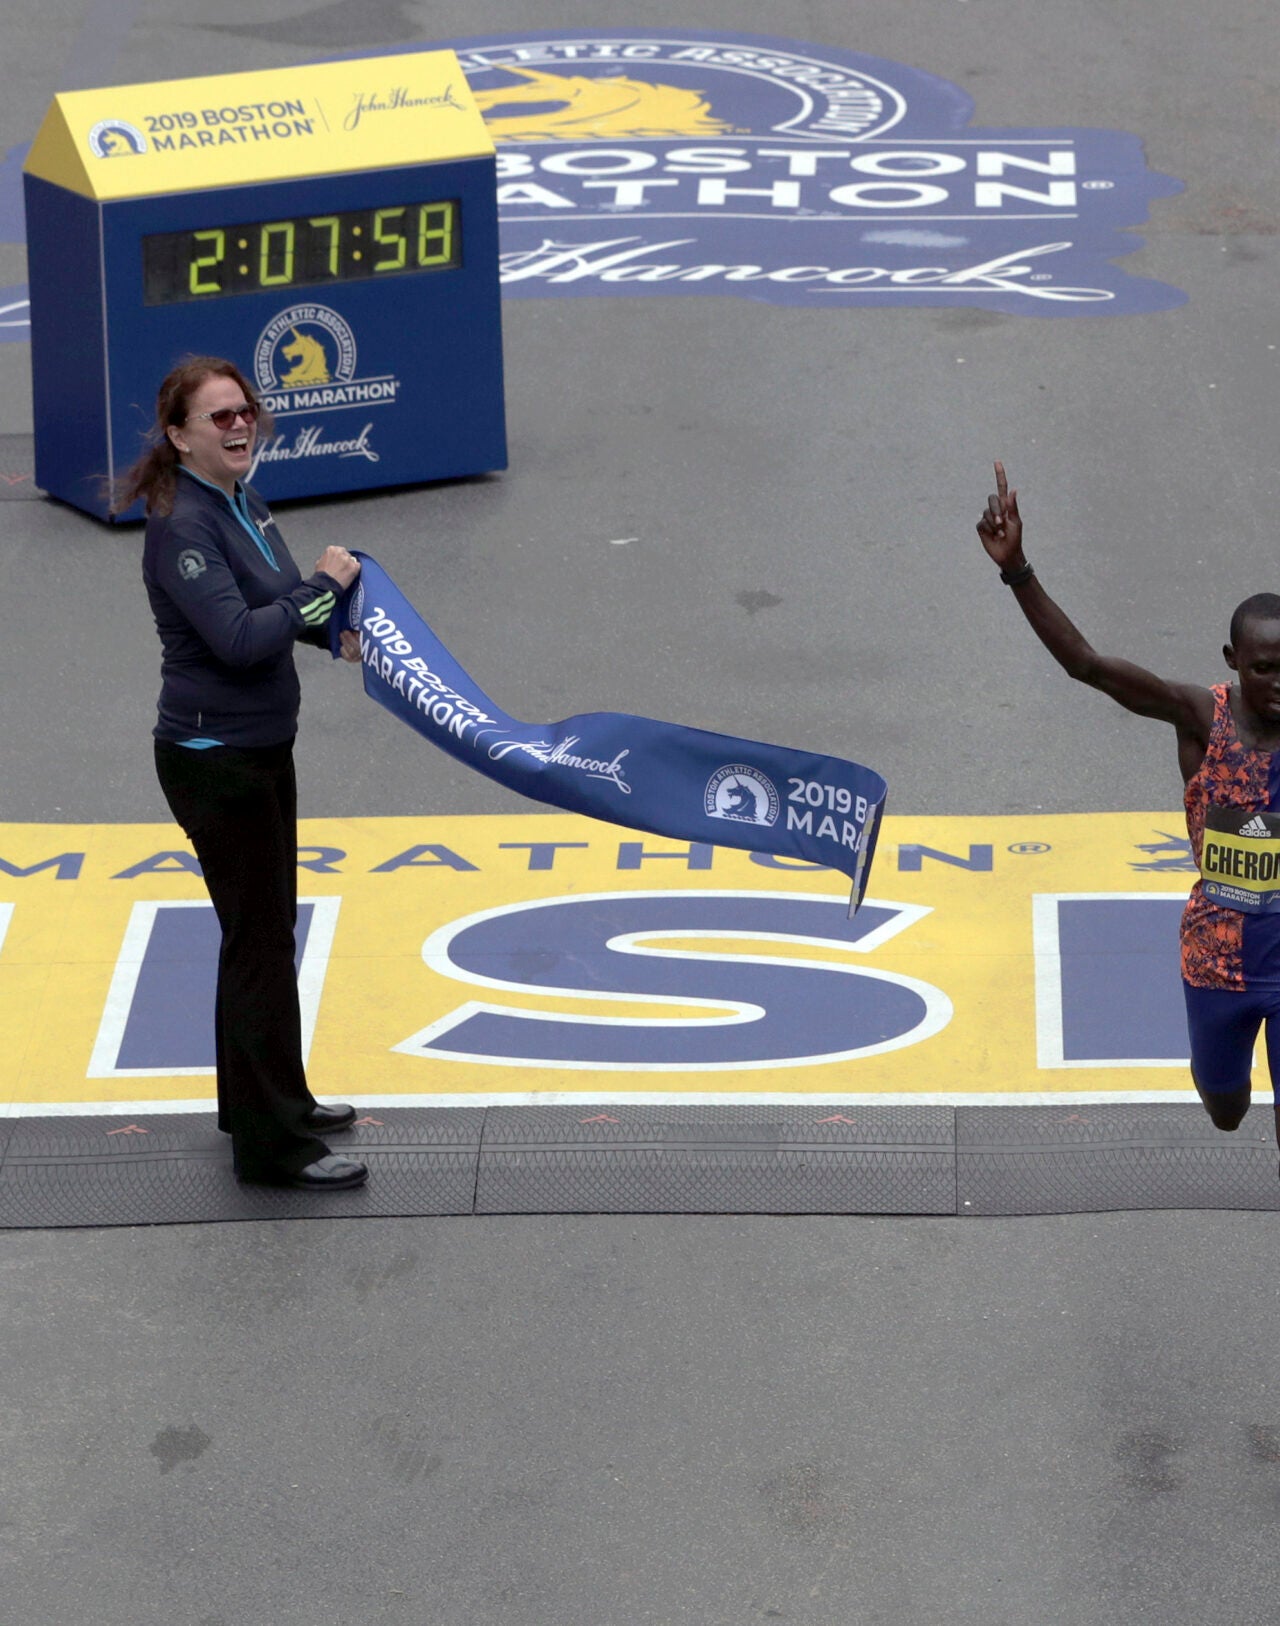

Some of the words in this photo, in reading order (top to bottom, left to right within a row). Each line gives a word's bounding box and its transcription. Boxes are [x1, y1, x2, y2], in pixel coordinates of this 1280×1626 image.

[461, 44, 660, 69] LETIC
[669, 47, 884, 133] ASSOCIATION
[144, 112, 198, 132] 2019
[201, 99, 305, 127] BOSTON
[151, 119, 314, 152] MARATHON
[497, 178, 1078, 208] ATHON
[189, 202, 453, 295] 2:07:58
[258, 339, 272, 385] BOSTON
[268, 307, 316, 341] ATHLETIC
[316, 308, 353, 374] ASSOCIATION
[294, 381, 396, 409] MARATHON
[290, 423, 380, 463] Hancock
[360, 630, 473, 739] MARATHON
[363, 606, 412, 655] 2019
[400, 656, 498, 725] BOSTON
[548, 735, 632, 794] Hancock
[707, 778, 719, 813] BOSTON
[717, 766, 752, 782] ATHLETIC
[752, 771, 778, 825] ASSOCIATION
[787, 777, 852, 814] 2019
[1238, 828, 1272, 838] adidas
[1220, 891, 1261, 906] MARATHON
